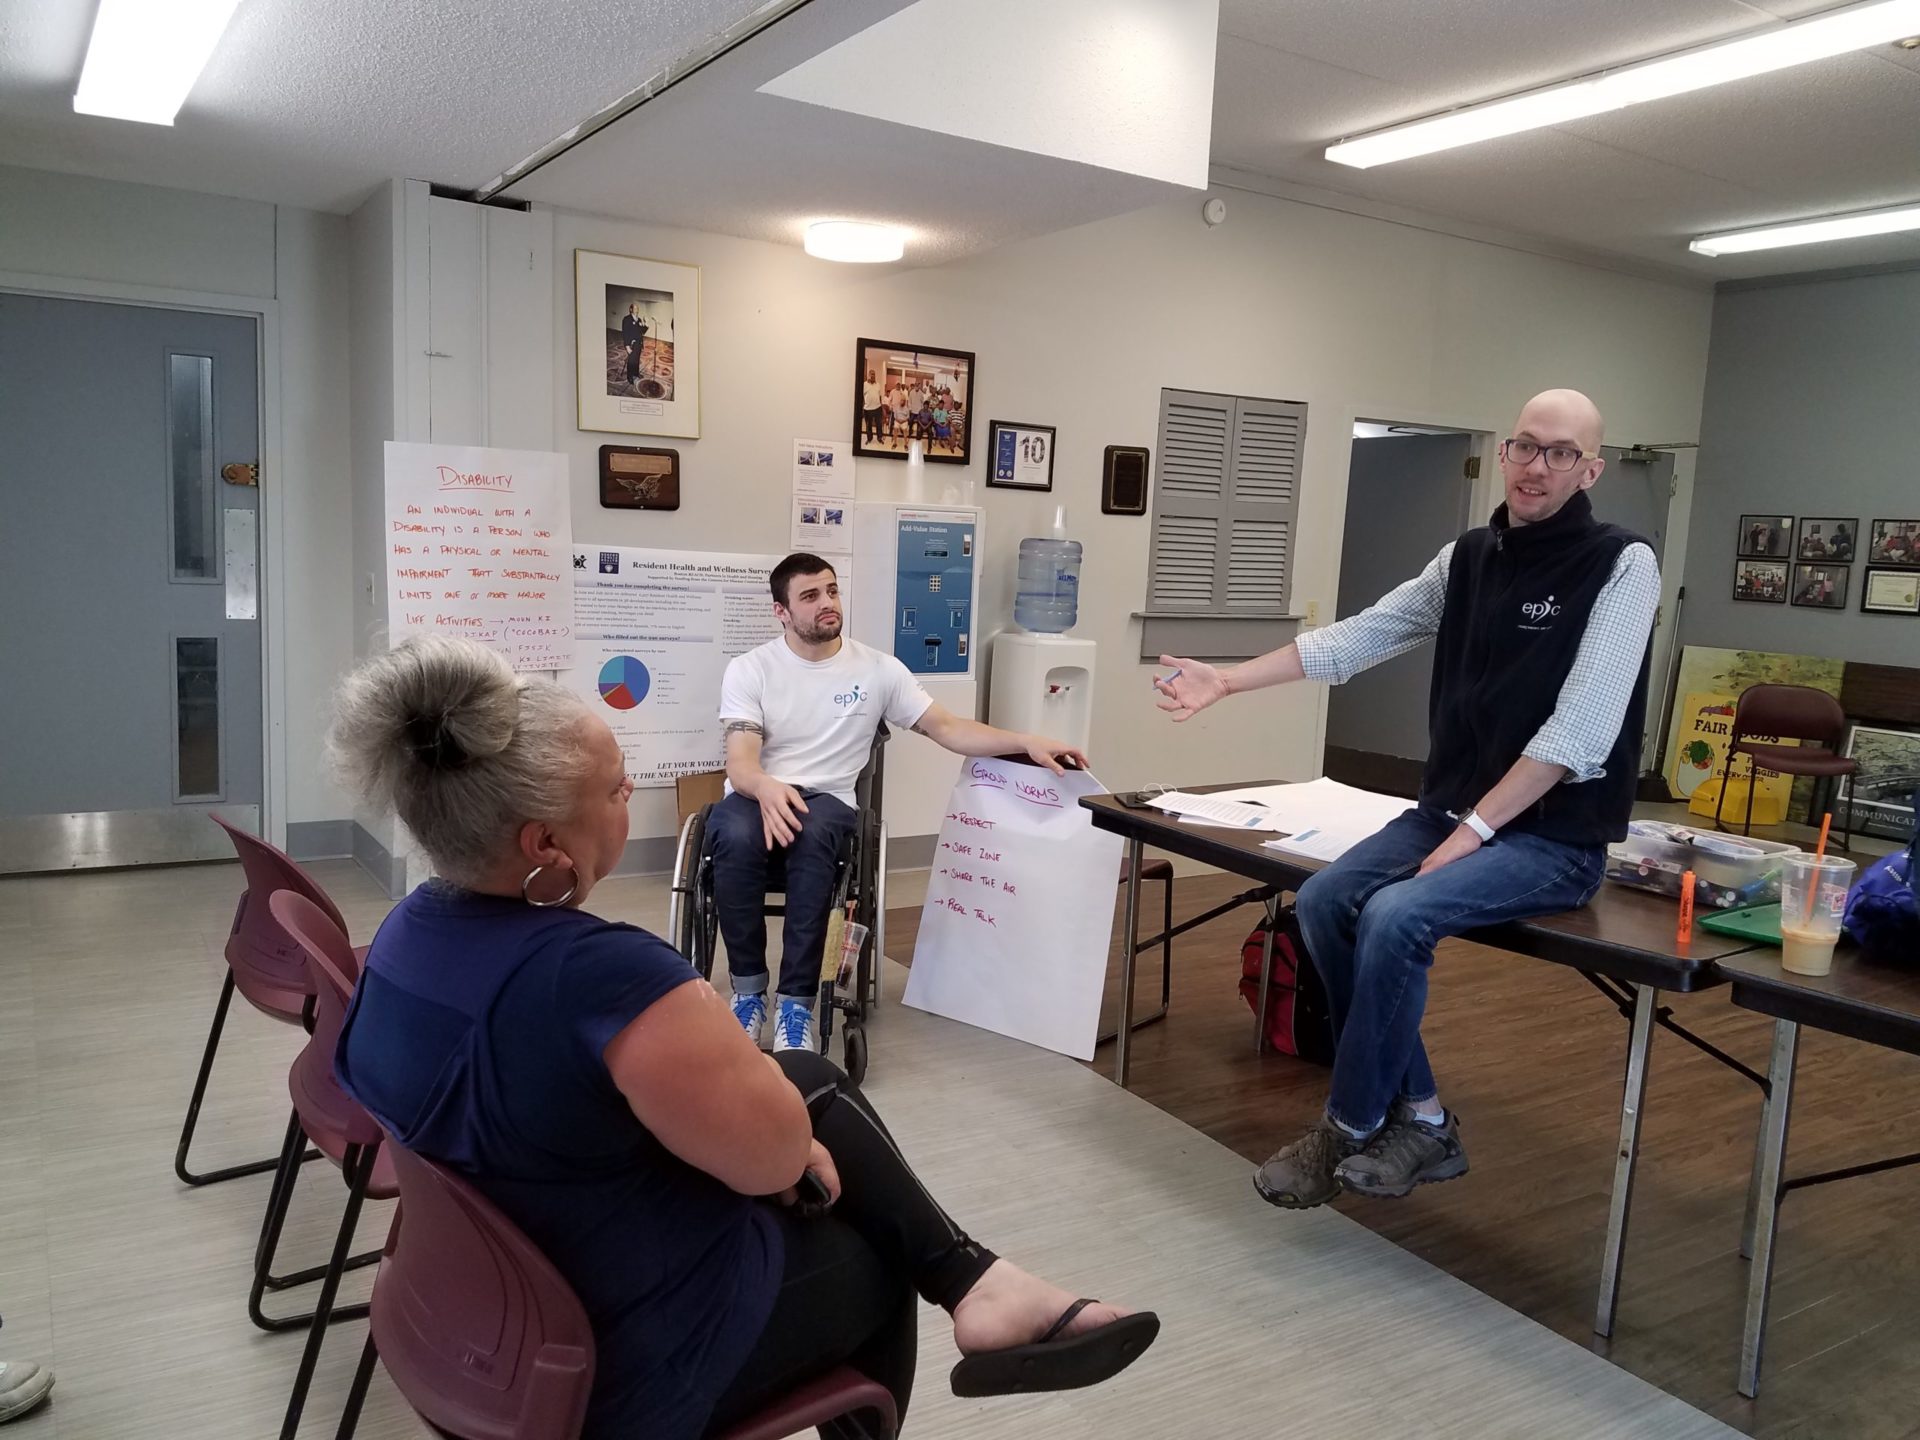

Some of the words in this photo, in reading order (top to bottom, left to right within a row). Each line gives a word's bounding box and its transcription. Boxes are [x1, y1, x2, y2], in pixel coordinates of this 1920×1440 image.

[1019, 436, 1046, 464] 10
[407, 504, 422, 515] AN
[433, 504, 484, 516] INDIVIDUAL
[494, 508, 515, 517] WITH
[524, 508, 531, 517] A
[453, 525, 464, 534] IS
[472, 526, 480, 534] A
[487, 525, 523, 537] PERSON
[533, 529, 551, 538] WHO
[393, 544, 412, 555] HAS
[422, 546, 430, 554] A
[440, 545, 483, 556] PHYSICAL
[489, 548, 501, 556] OR
[512, 547, 551, 557] MENTAL
[466, 568, 494, 578] THAT
[632, 561, 668, 571] Resident
[669, 563, 696, 572] Health
[697, 564, 712, 573] and
[713, 565, 747, 575] Wellness
[399, 589, 432, 600] LIMITS
[444, 591, 462, 599] ONE
[517, 591, 546, 600] MAJOR
[1522, 594, 1561, 624] epic
[406, 612, 426, 625] LIFE
[833, 684, 868, 708] epic
[1694, 719, 1728, 736] FAIR
[657, 762, 672, 770] LET
[674, 761, 696, 770] YOUR
[697, 759, 721, 768] VOICE
[640, 772, 657, 780] THE
[657, 771, 681, 779] NEXT
[1745, 766, 1780, 779] VGGIES
[971, 761, 1008, 785] GROUP
[1015, 780, 1059, 801] NORMS
[958, 811, 997, 830] RESPECT
[1838, 806, 1917, 826] CMMUNICAT
[951, 841, 972, 856] SAFE
[979, 847, 1001, 862] ZONE
[950, 867, 973, 882] SHARE
[980, 876, 996, 888] THE
[1003, 881, 1017, 897] AIR
[947, 897, 967, 916] REAL
[973, 908, 997, 928] TALK
